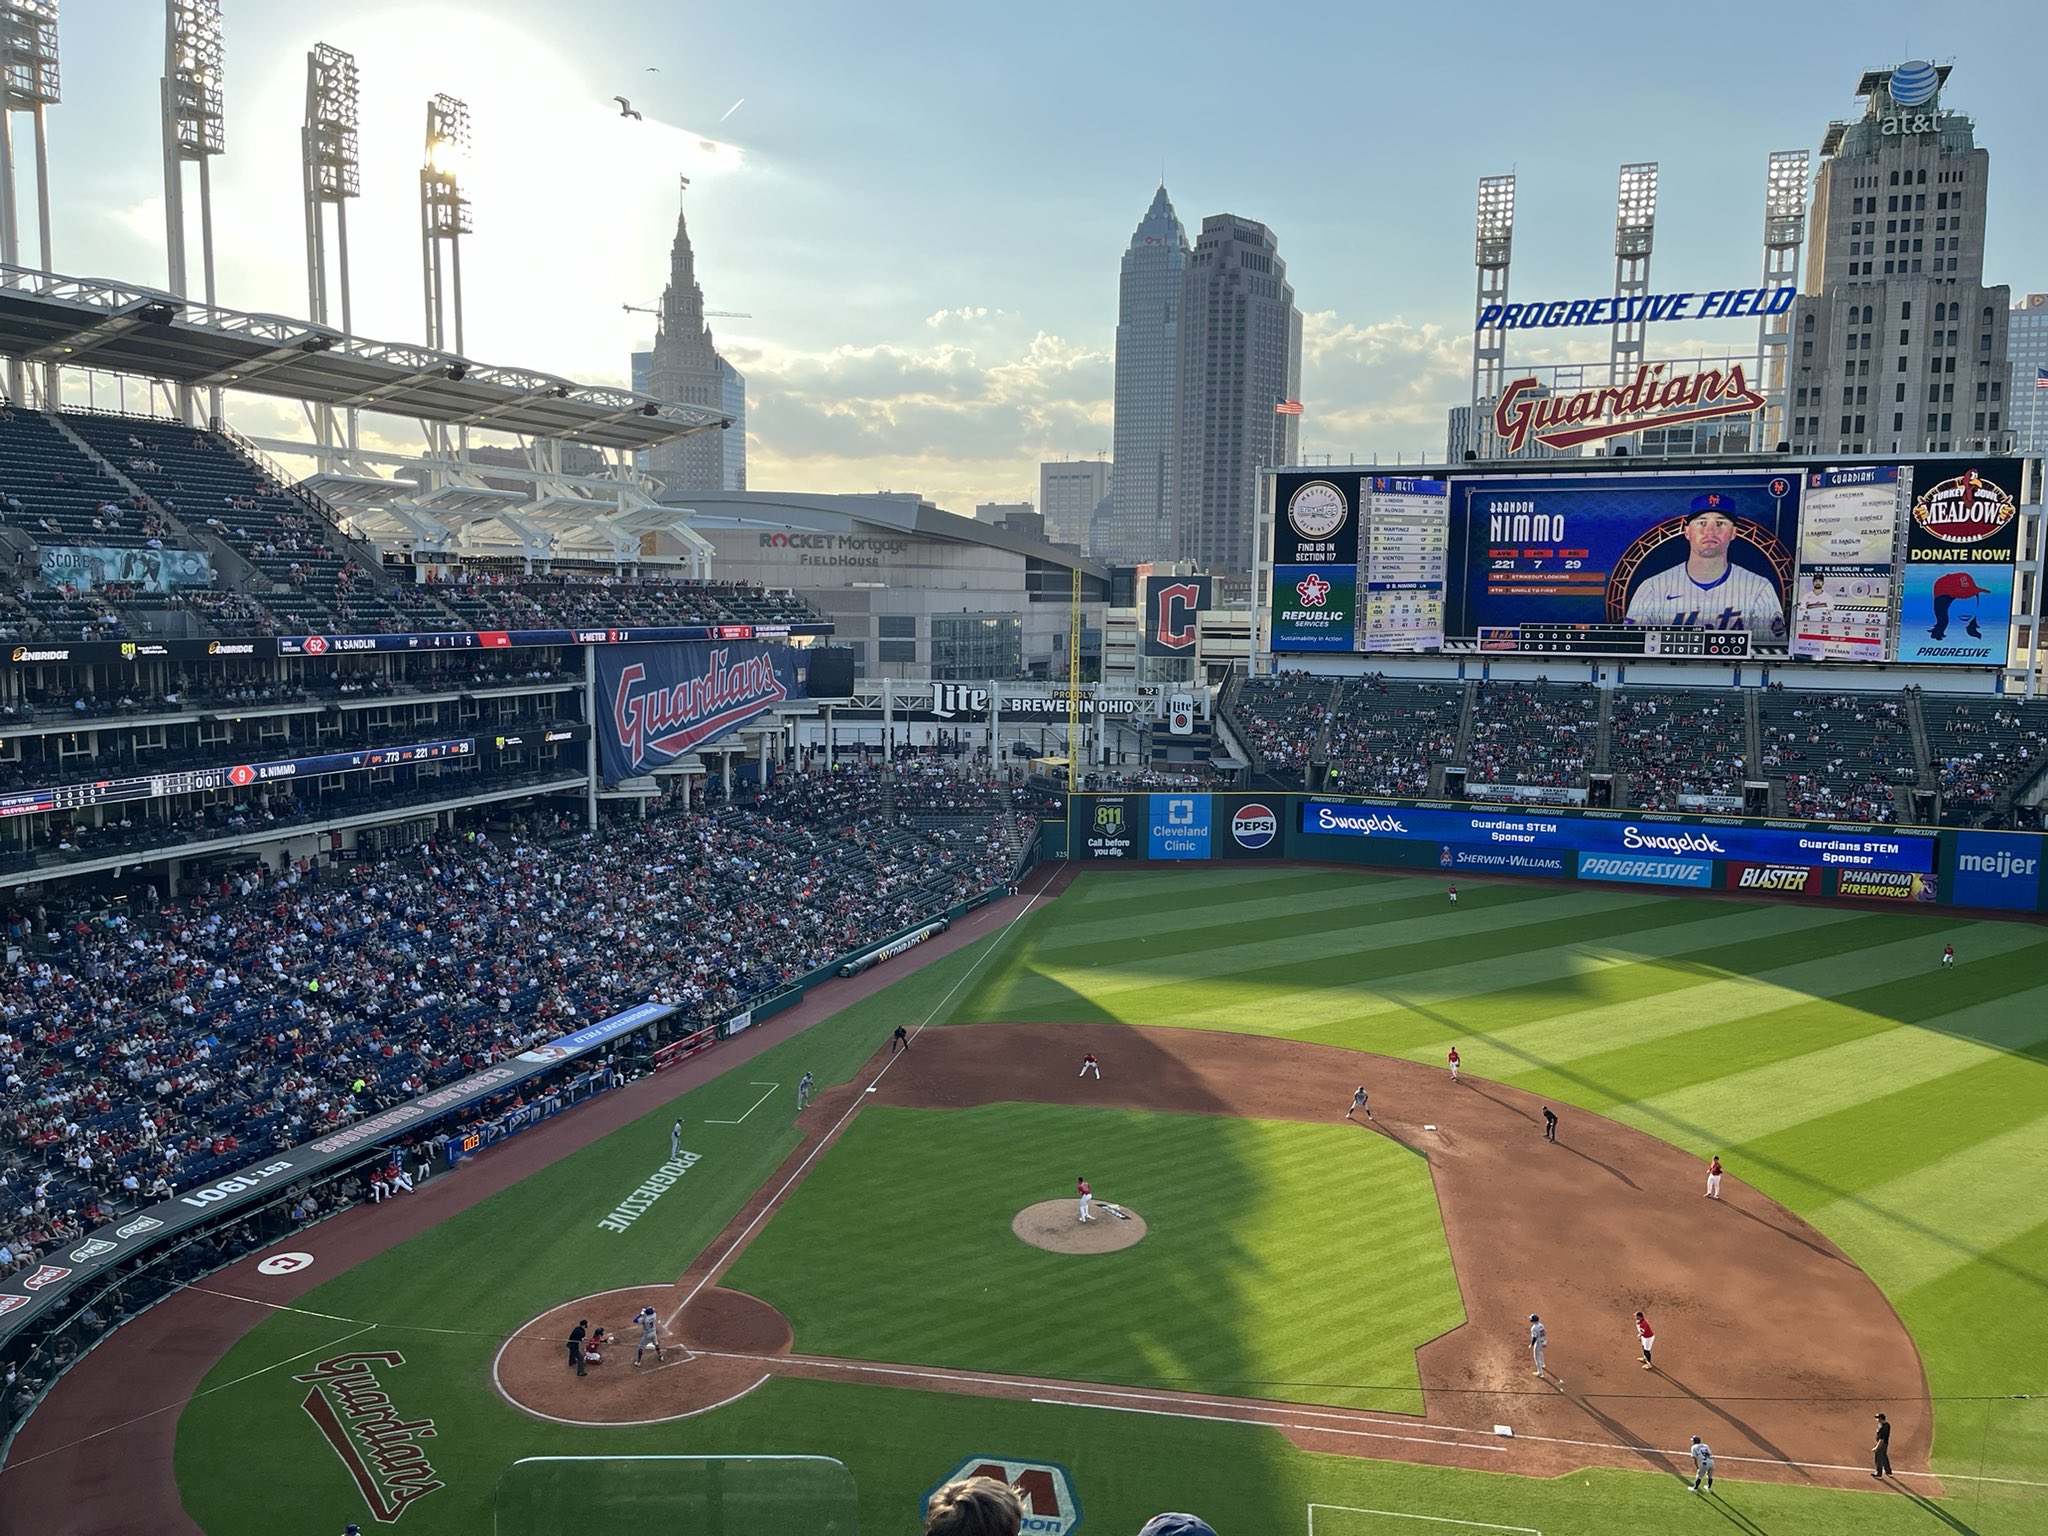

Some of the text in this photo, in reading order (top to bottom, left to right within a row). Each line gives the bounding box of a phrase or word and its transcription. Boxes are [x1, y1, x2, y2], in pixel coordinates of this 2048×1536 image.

[1881, 108, 1942, 135] at&t
[1476, 287, 1796, 331] PROGRESSIVE FIELD
[1495, 362, 1767, 454] Guardians
[1832, 472, 1874, 484] GUARDIANS
[1932, 487, 1998, 502] TURKEY BOWL
[1490, 502, 1535, 513] BRANDON
[1922, 500, 2008, 526] MEADOWS
[1490, 514, 1565, 542] NIMMO
[760, 533, 907, 555] ROCKET Mortgage
[1298, 543, 1335, 552] FIND US IN
[47, 553, 90, 568] SCORE
[1296, 553, 1337, 562] SECTION 117
[1911, 549, 2010, 561] DONATE NOW!
[1491, 560, 1582, 569] .221 7 29
[1156, 583, 1200, 650] C
[1282, 611, 1343, 621] REPUBLIC
[580, 632, 606, 642] K-METER
[611, 632, 616, 641] 2
[1280, 635, 1317, 643] Sustainability
[1718, 636, 1725, 644] 0
[1738, 636, 1745, 644] 0
[121, 643, 136, 655] 811
[216, 645, 253, 654] ENBRIDGE
[310, 636, 471, 651] 52 N. SANDLIN 4 5
[22, 651, 69, 661] ENBRIDGE
[1917, 648, 1991, 657] PROGRESSIVE
[930, 681, 988, 718] Lite
[614, 648, 787, 769] Guardians
[1011, 699, 1134, 713] BREWED IN OHIO
[1173, 701, 1191, 713] Lite
[238, 770, 246, 782] 9
[268, 764, 296, 777] NIMMO
[384, 752, 400, 763] .773
[414, 748, 428, 758] .221
[441, 746, 446, 755] 7
[196, 777, 203, 789] 0
[206, 776, 212, 788] 0
[215, 775, 220, 786] 1
[1310, 796, 1346, 804] PROGRESSIVE
[1362, 799, 1398, 807] PROGRESSIVE
[1415, 802, 1452, 810] PROGRESSIVE
[2, 805, 39, 814] CLEVELAND
[1470, 805, 1508, 813] PROGRESSIVE
[1526, 808, 1566, 816] PROGRESSIVE
[1582, 810, 1623, 819] PROGRESSIVE
[1097, 807, 1121, 825] 811
[1319, 808, 1408, 834] Swagelok
[1641, 814, 1682, 822] PROGRESSIVE
[1701, 817, 1744, 826] PROGRESSIVE
[1153, 826, 1208, 837] Cleveland
[1235, 822, 1274, 831] PEPSI
[1471, 820, 1557, 833] Guardians STEM
[1764, 821, 1808, 830] PROGRESSIVE
[1827, 824, 1872, 833] PROGRESSIVE
[1491, 832, 1535, 843] Sponsor
[1893, 828, 1940, 837] PROGRESSIVE
[1088, 839, 1130, 847] Call before
[1164, 840, 1196, 851] Clinic
[1623, 826, 1725, 855] Swagelok
[1799, 839, 1899, 853] Guardians STEM
[1094, 848, 1124, 857] you dig.
[1823, 853, 1873, 865] Sponsor
[1959, 851, 2036, 878] meijer
[1581, 858, 1704, 880] PROGRESSIVE
[1739, 868, 1808, 891] BLASTER
[1842, 871, 1912, 886] PHANTOM
[1840, 884, 1911, 898] FIREWORKS
[574, 1007, 658, 1044] PROGRESSIVE FIELD
[311, 1068, 515, 1153] CLEVELAND GUARDIANS
[181, 1161, 293, 1207] EST. 1901
[597, 1149, 703, 1234] PROGRESSIVE
[292, 1350, 446, 1524] Guardians
